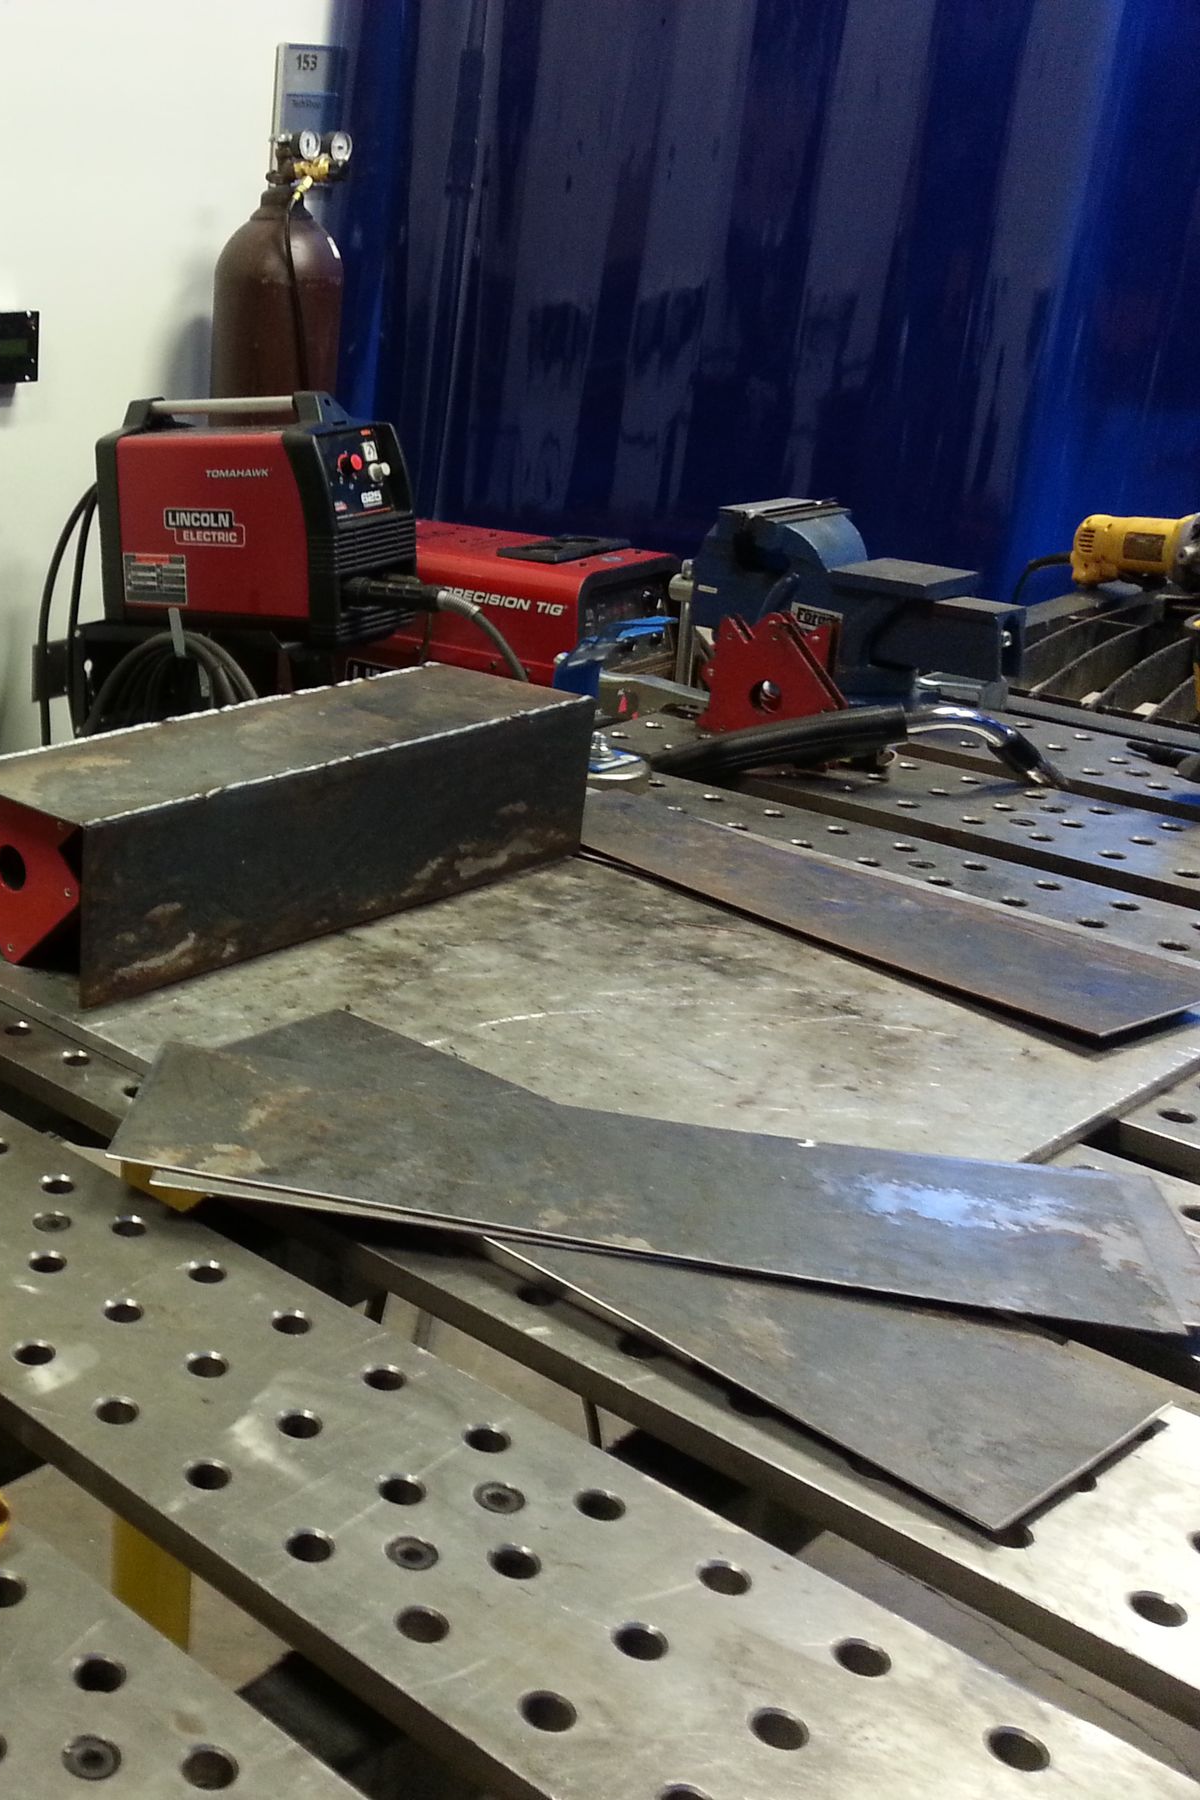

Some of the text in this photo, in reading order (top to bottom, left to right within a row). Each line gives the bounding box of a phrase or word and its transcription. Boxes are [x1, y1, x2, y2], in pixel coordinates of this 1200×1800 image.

[296, 54, 318, 71] 153
[205, 468, 269, 479] TOMAHAWK
[168, 511, 230, 528] LINCOLN
[183, 530, 237, 543] ELECTRIC
[536, 601, 564, 616] TIG
